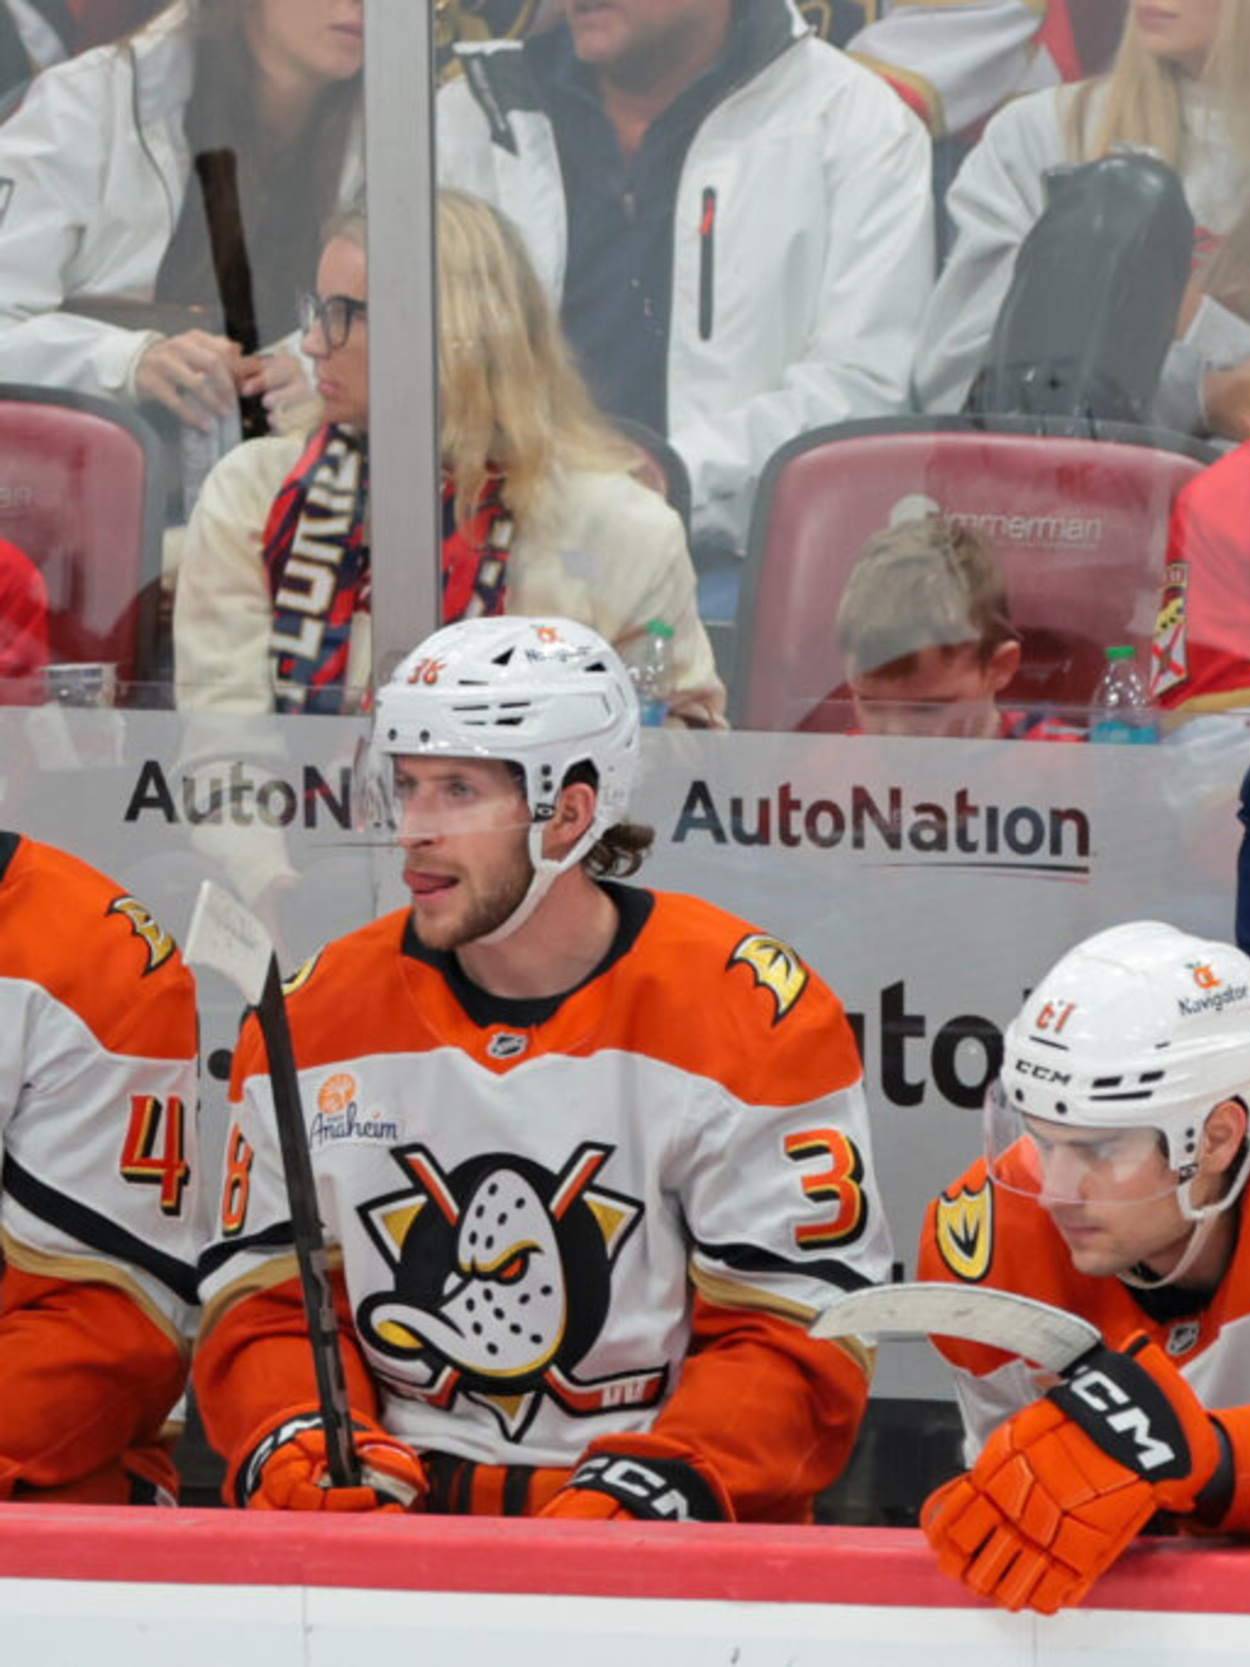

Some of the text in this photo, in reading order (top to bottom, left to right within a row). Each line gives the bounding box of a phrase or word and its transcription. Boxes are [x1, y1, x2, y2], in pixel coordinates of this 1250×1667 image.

[123, 760, 352, 830] AutoN
[671, 780, 1091, 857] AutoNation
[1178, 985, 1248, 1015] Navigator
[1015, 1058, 1071, 1086] CCM
[120, 1094, 190, 1217] 4
[309, 1101, 398, 1149] Anaheim
[784, 1127, 869, 1252] 3
[1062, 1365, 1176, 1471] CM
